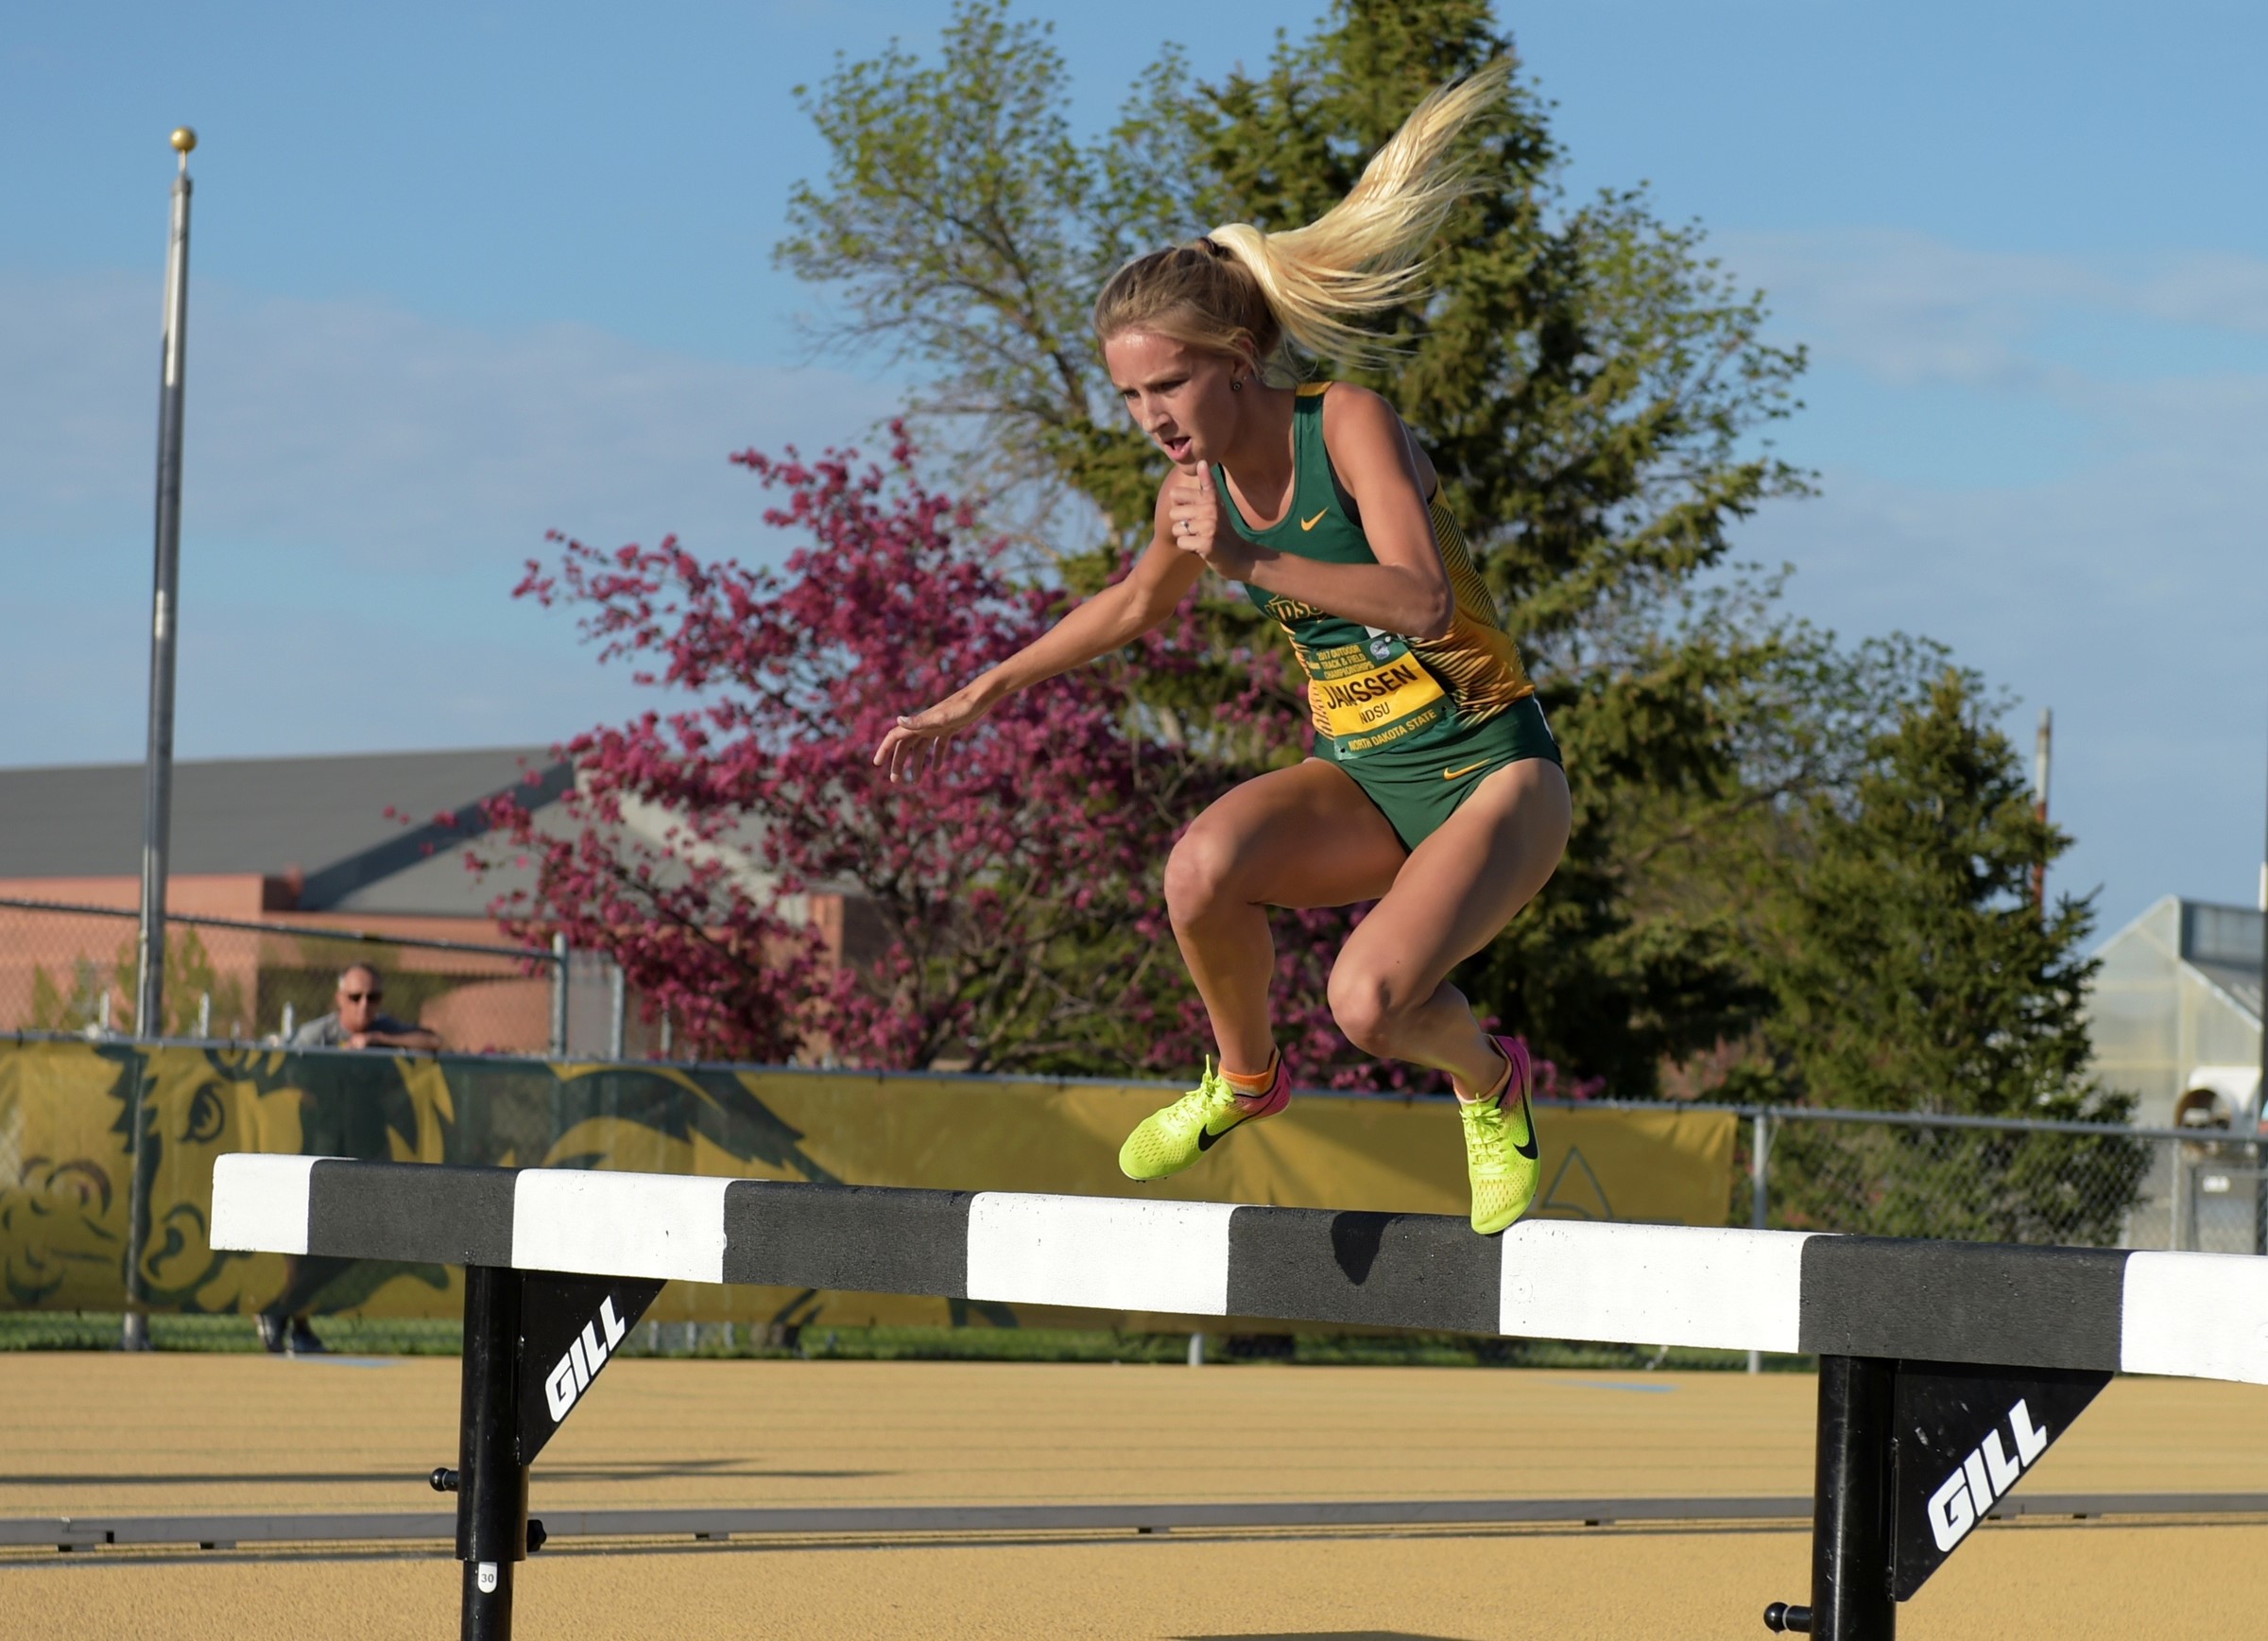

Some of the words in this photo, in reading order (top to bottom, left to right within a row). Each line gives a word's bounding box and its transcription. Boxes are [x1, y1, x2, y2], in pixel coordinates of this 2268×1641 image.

[1321, 658, 1341, 669] TRACK
[1341, 657, 1349, 665] &
[1347, 653, 1366, 665] FIELD
[1331, 645, 1361, 659] OUTDOOR
[1359, 701, 1390, 724] NDSU
[1348, 737, 1372, 751] NORTH
[1371, 725, 1407, 746] DAKOTA
[1406, 709, 1436, 731] STATE
[545, 1295, 626, 1423] GILL
[1928, 1398, 2047, 1552] GILL
[481, 1573, 494, 1583] 30
